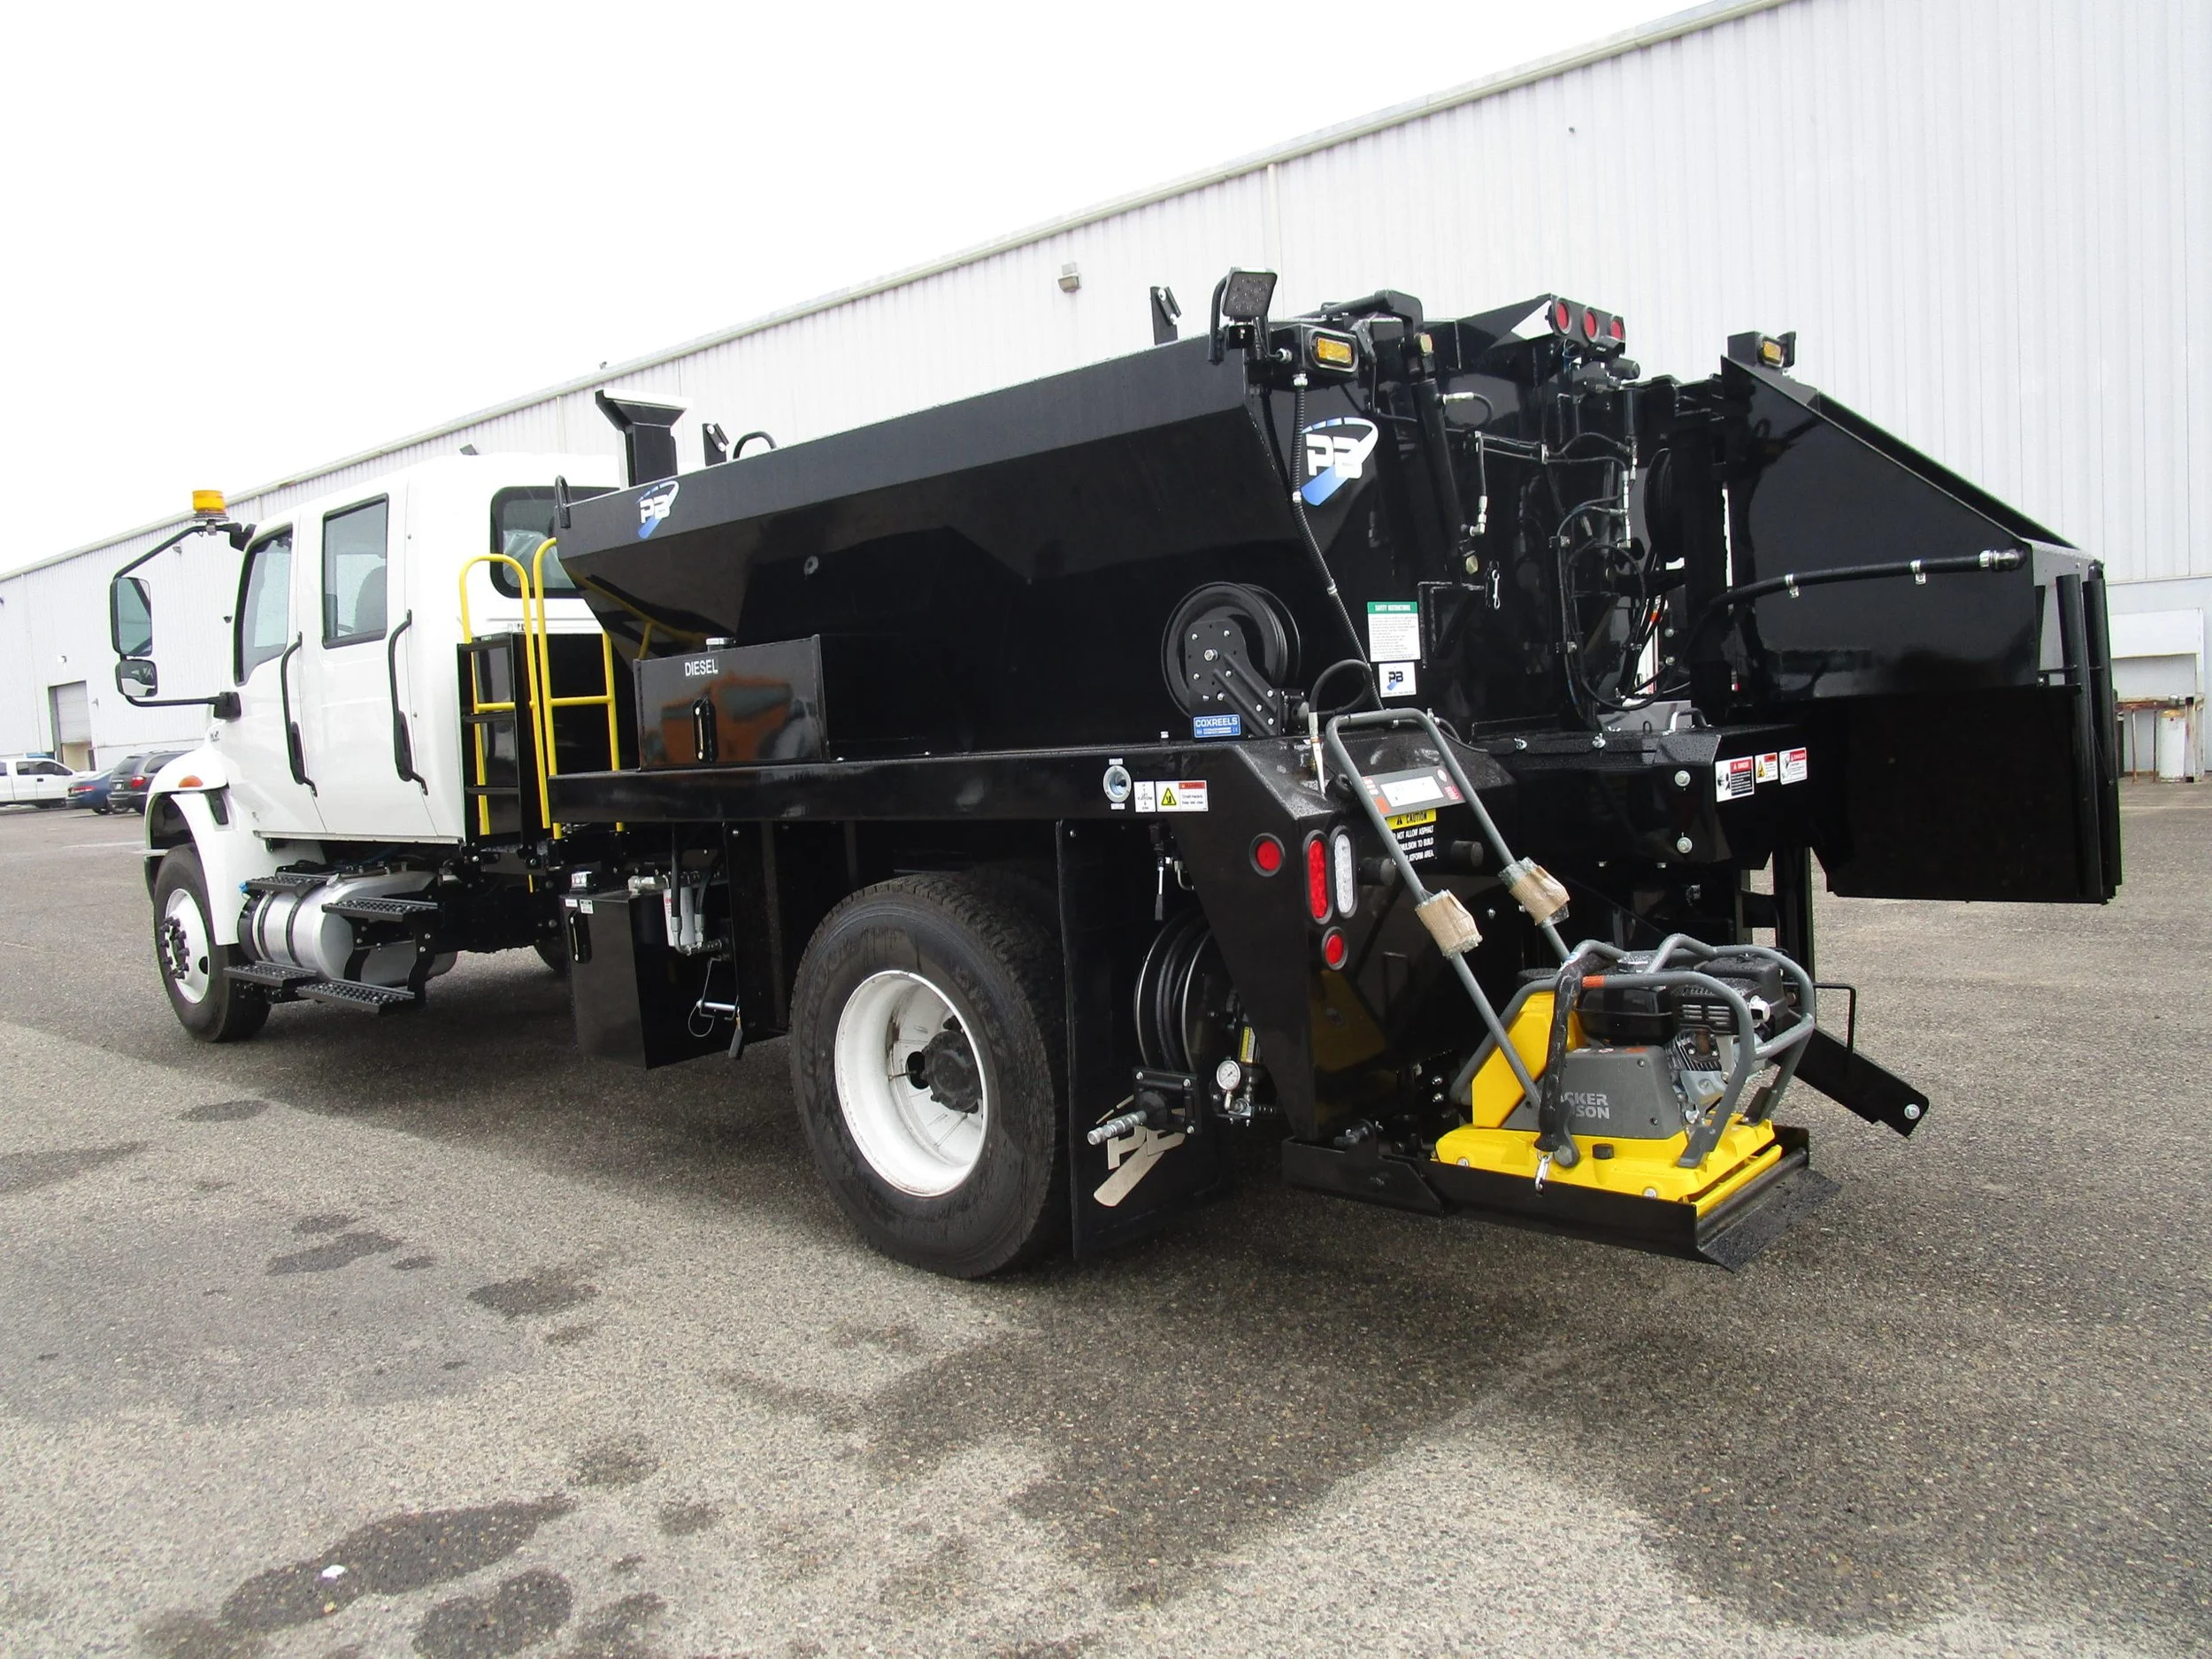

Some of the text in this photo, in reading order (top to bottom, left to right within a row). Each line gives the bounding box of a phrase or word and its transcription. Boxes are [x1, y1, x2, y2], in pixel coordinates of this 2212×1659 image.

[684, 658, 718, 677] DIESEL
[1195, 717, 1238, 727] COXREELS
[1406, 810, 1427, 824] CAUTION
[1405, 828, 1418, 838] ALLOW
[1418, 825, 1433, 835] ASPHALT
[1399, 837, 1433, 850] MULSION TO BUILD
